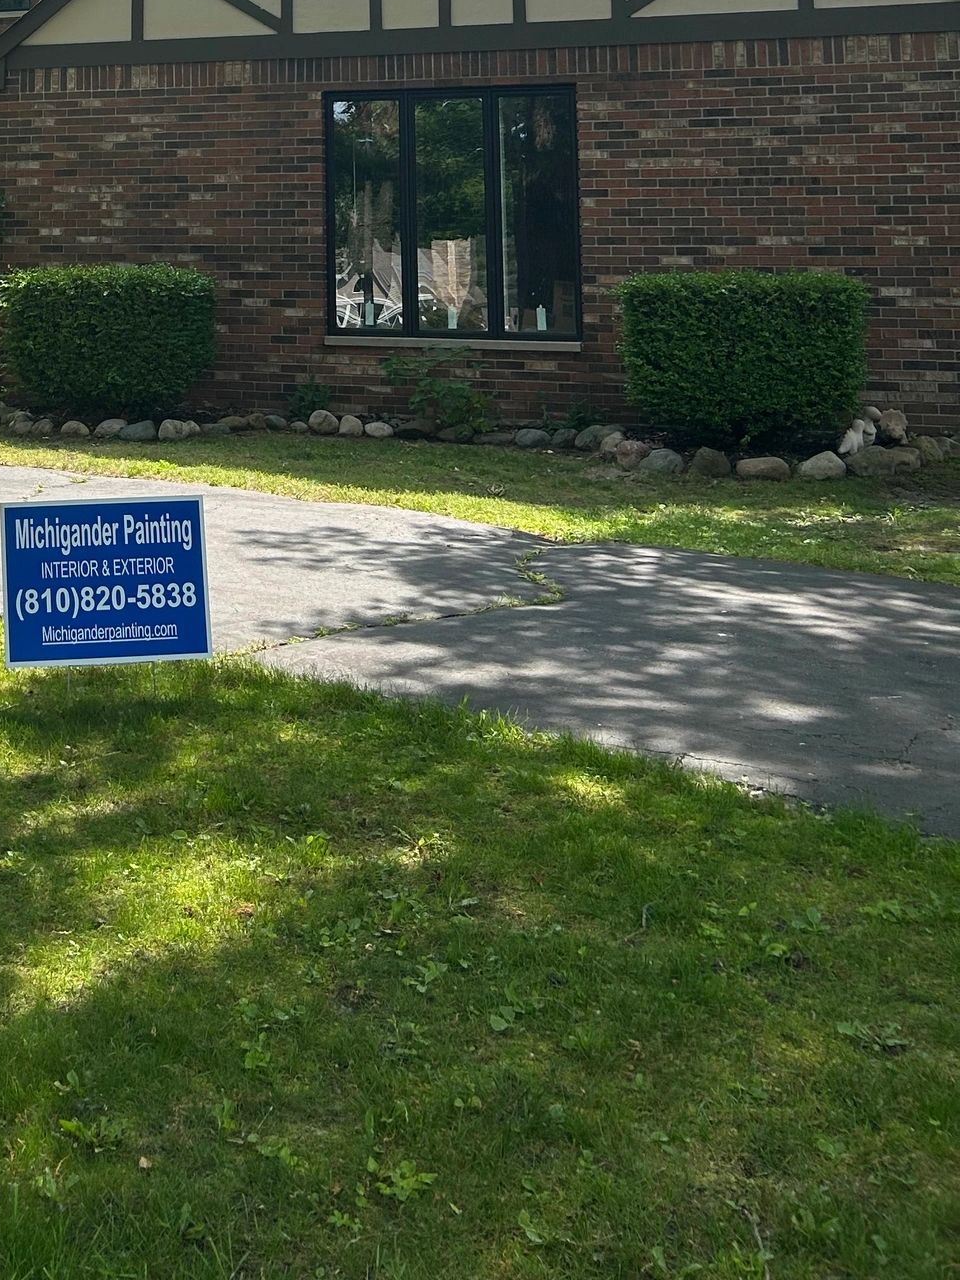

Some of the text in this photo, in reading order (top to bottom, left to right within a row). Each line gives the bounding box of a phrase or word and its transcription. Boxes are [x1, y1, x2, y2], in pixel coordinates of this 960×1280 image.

[15, 513, 193, 556] Michigander Painting
[41, 557, 175, 579] INTERIOR & EXTERIOR
[15, 582, 197, 621] (810)820-5838
[42, 622, 178, 644] Michiganderpainting.com
